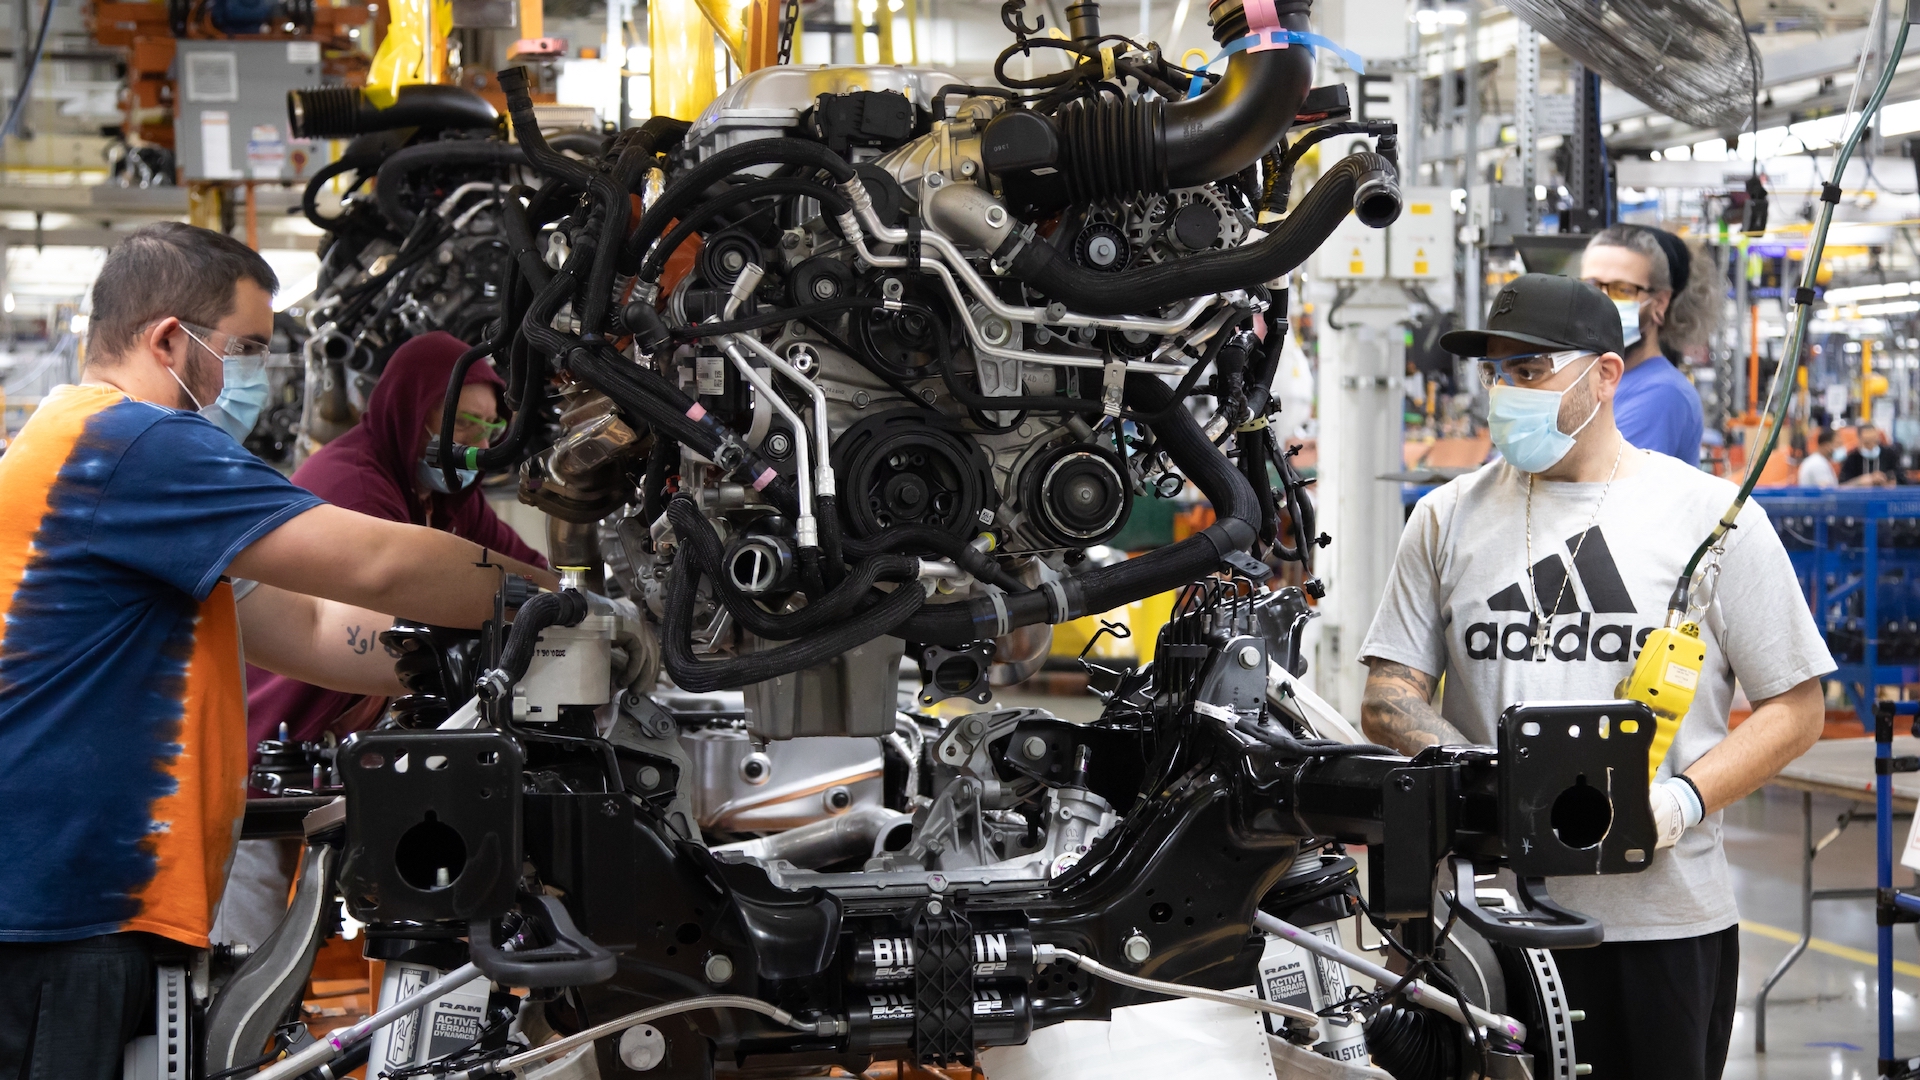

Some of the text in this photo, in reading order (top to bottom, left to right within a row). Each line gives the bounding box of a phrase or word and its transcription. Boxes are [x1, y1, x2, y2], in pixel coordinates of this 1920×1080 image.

[1265, 962, 1300, 975] RAM
[1270, 973, 1305, 989] ACTIVE
[1271, 980, 1306, 994] TERRAIN
[1272, 987, 1308, 1001] DYNAMICS
[439, 1002, 482, 1012] RAM
[436, 1014, 478, 1028] ACTIVE
[433, 1030, 476, 1041] DYNAMICS
[435, 1023, 477, 1035] TERRAIN
